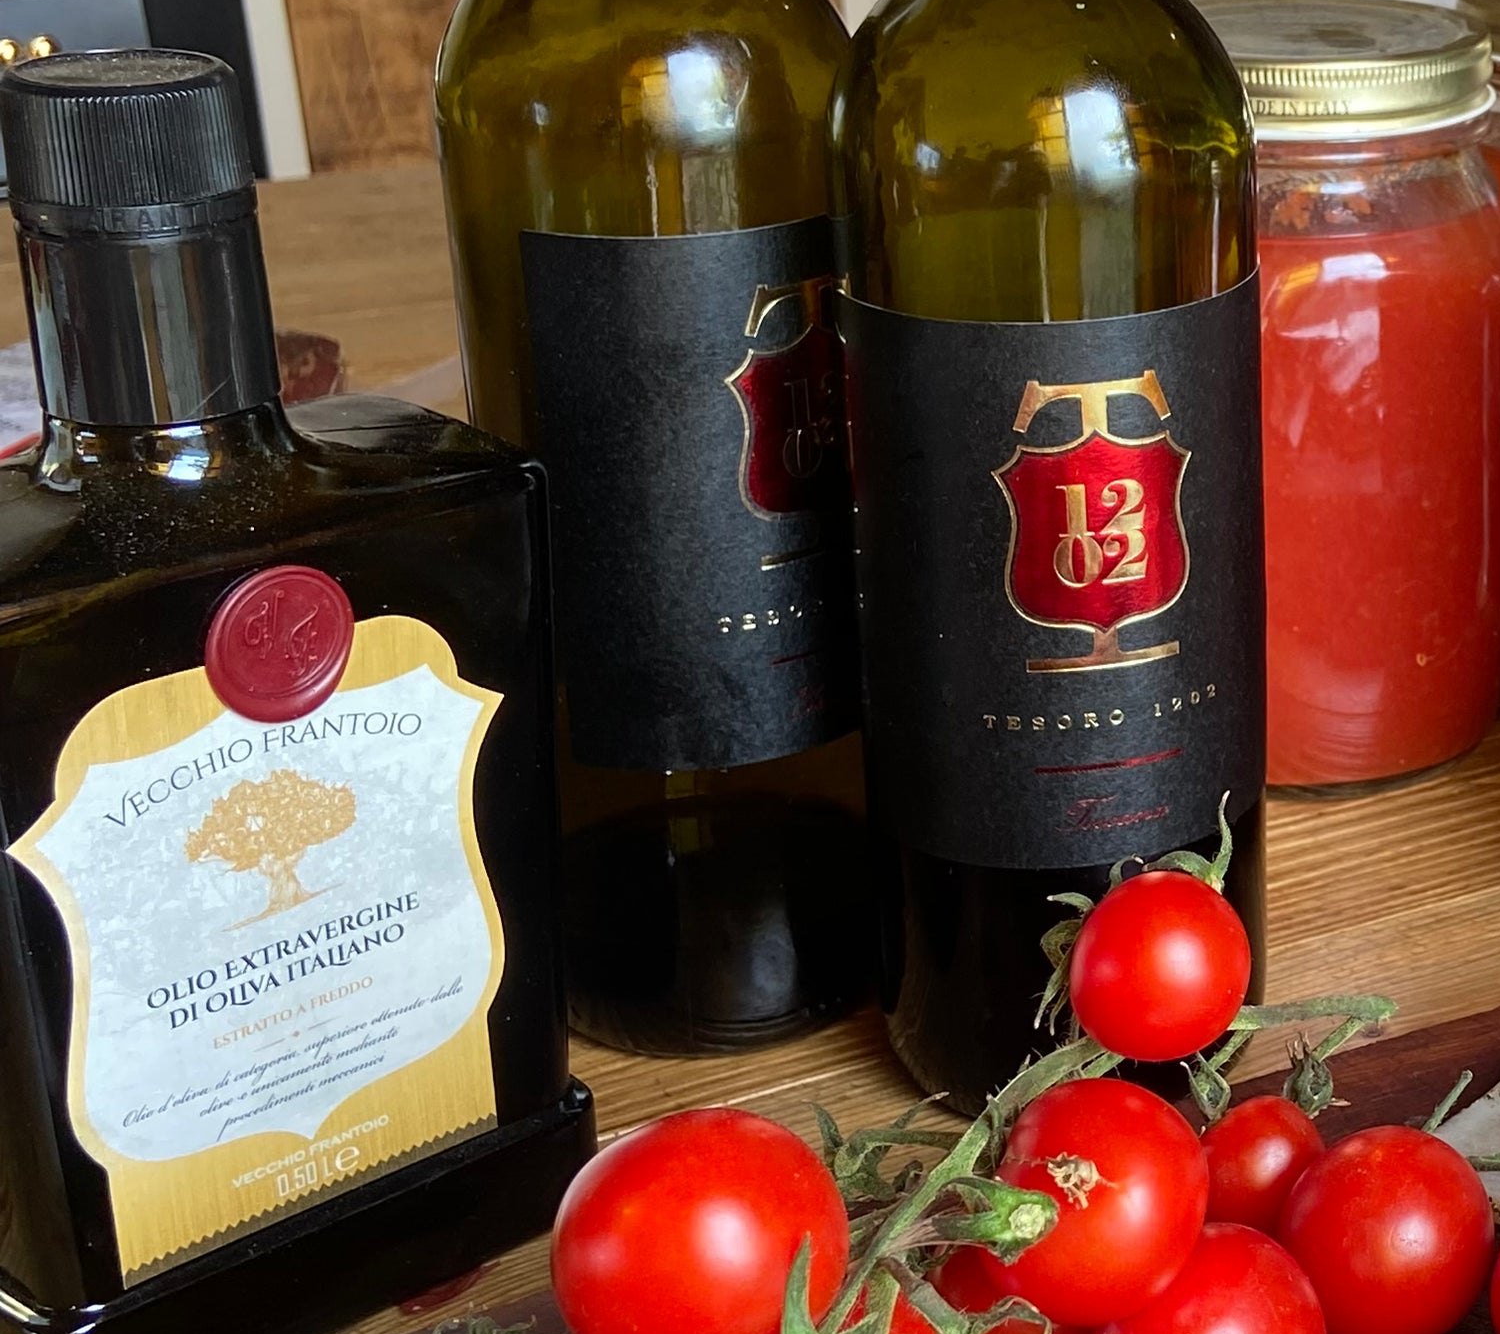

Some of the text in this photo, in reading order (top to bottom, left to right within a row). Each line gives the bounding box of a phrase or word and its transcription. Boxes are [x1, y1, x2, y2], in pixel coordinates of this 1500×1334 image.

[1249, 99, 1350, 115] ADE IN ITALY
[1055, 478, 1148, 537] 12
[1053, 528, 1148, 588] 02
[983, 683, 1216, 731] TESORO 1202
[104, 711, 422, 828] VECCHIO FRANTOIO
[147, 891, 420, 1009] OLIO EXTRAVERGINE
[169, 923, 405, 1030] DI OLIVA ITALIANO
[213, 976, 374, 1049] ESTRATTO A FREDDO
[123, 1104, 155, 1128] Olio
[215, 1070, 230, 1090] di
[233, 1048, 298, 1087] categoria
[304, 1024, 367, 1060] superiore
[371, 997, 426, 1026] ottenuto
[430, 974, 464, 1004] dalle
[200, 1096, 234, 1118] olive
[251, 1052, 332, 1096] unicamente
[336, 1027, 399, 1060] mediante
[216, 1051, 386, 1143] procedimenti meccanici
[231, 1114, 389, 1188] VECCHIO FRANTOIO
[277, 1161, 318, 1197] 0.50
